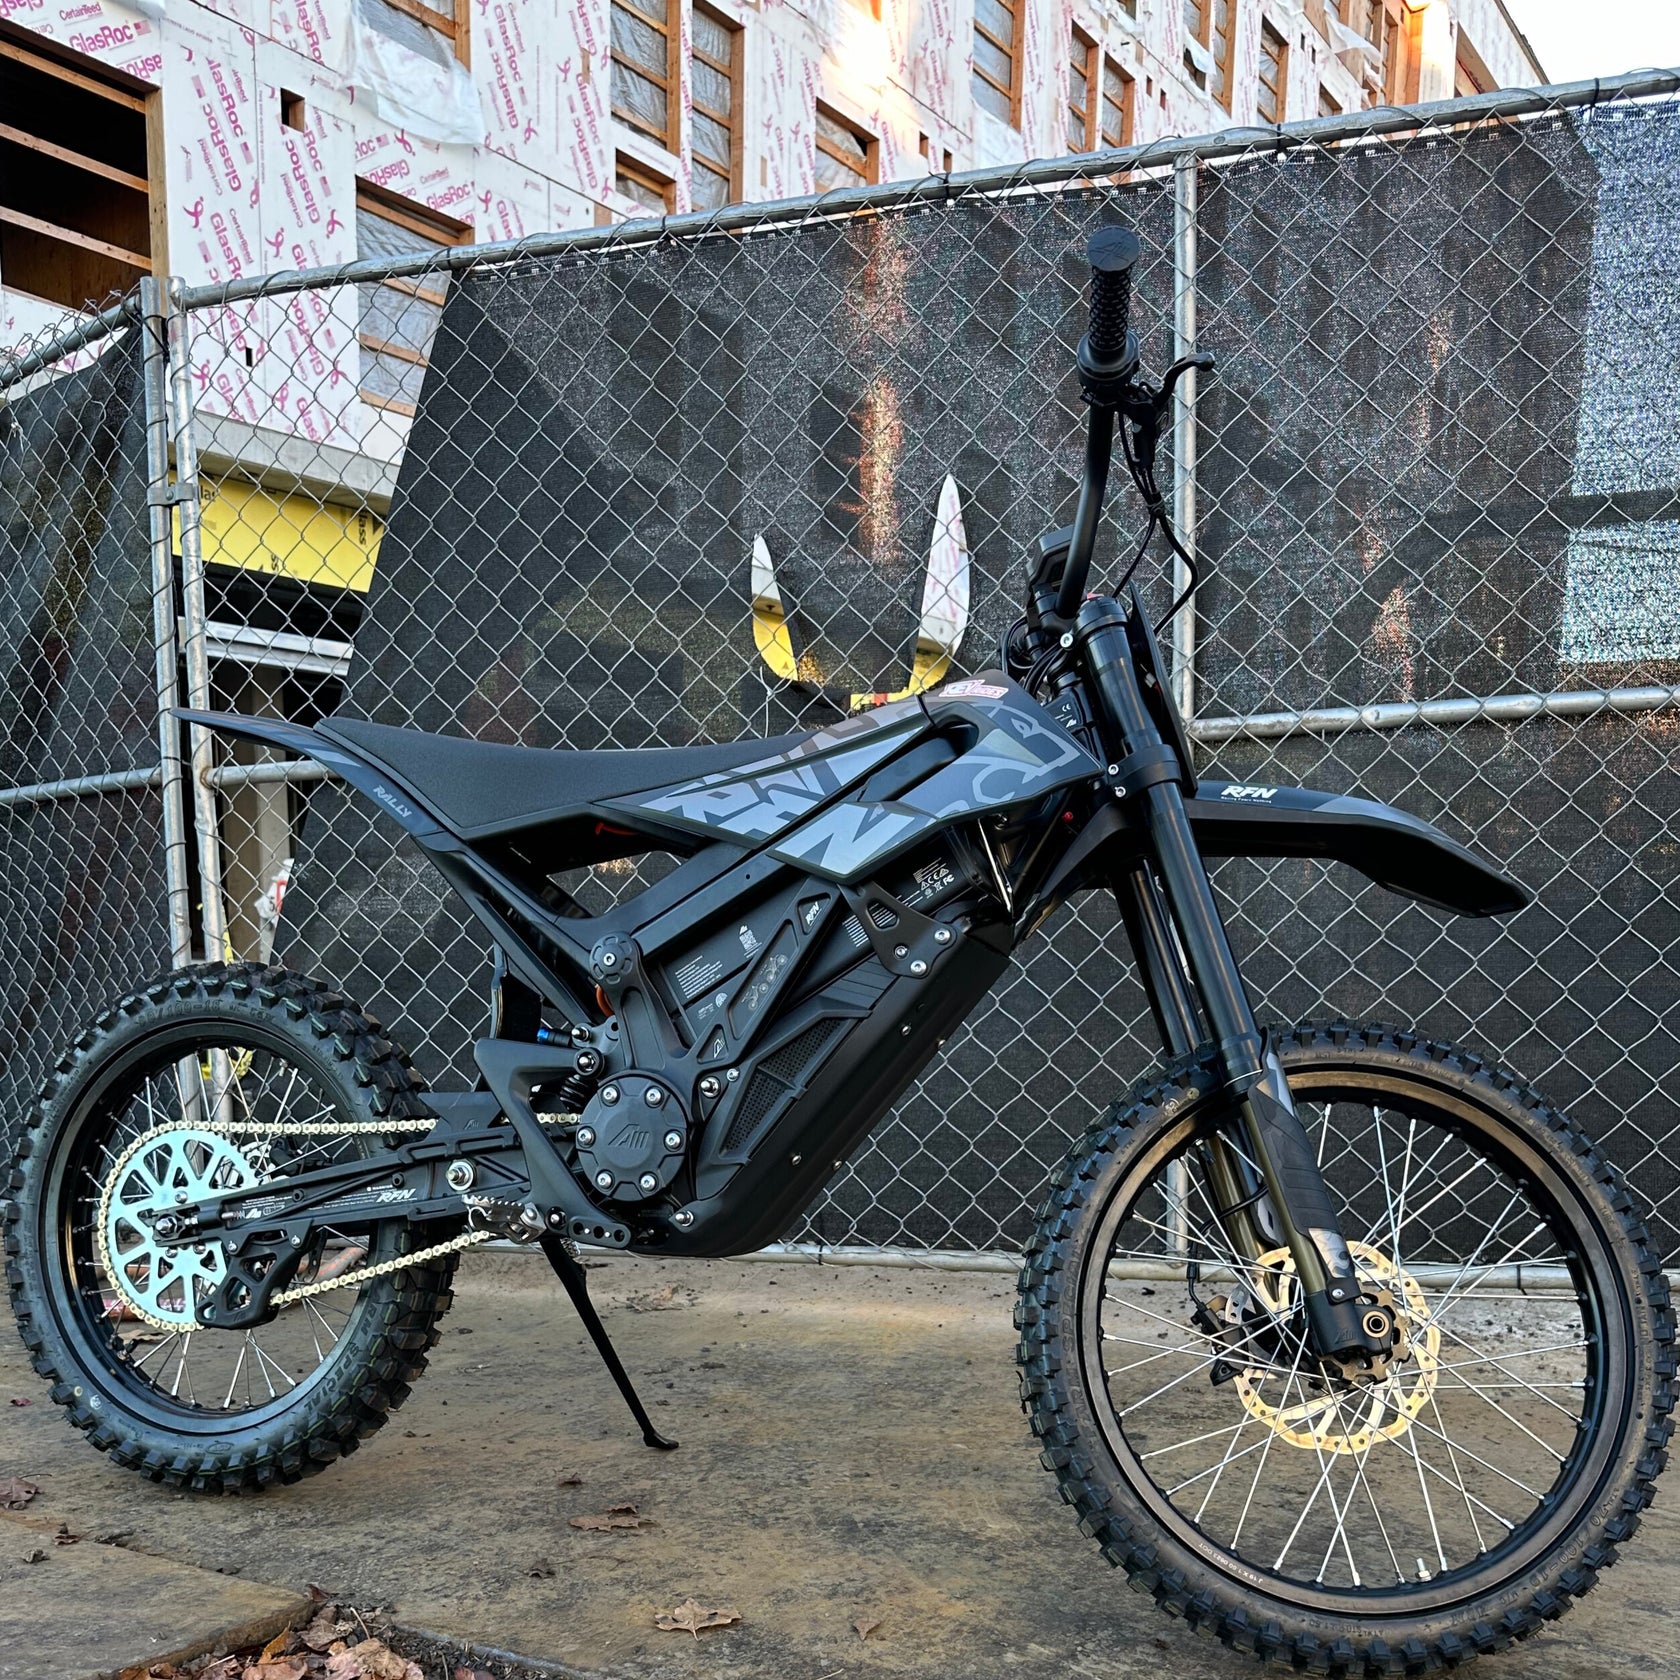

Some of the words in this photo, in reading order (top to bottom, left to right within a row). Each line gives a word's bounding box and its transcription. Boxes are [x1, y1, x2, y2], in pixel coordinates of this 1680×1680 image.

[69, 24, 134, 54] GlasRoc
[494, 4, 521, 82] GlasRoc
[492, 51, 518, 129] GlasRoc
[203, 102, 242, 192] GlasRoc
[285, 139, 321, 224] GlasRoc
[373, 785, 412, 818] RALLY
[1221, 785, 1278, 799] RFN
[806, 901, 820, 925] RFN
[376, 1188, 417, 1203] RFN
[304, 1342, 361, 1414] SPECIAL
